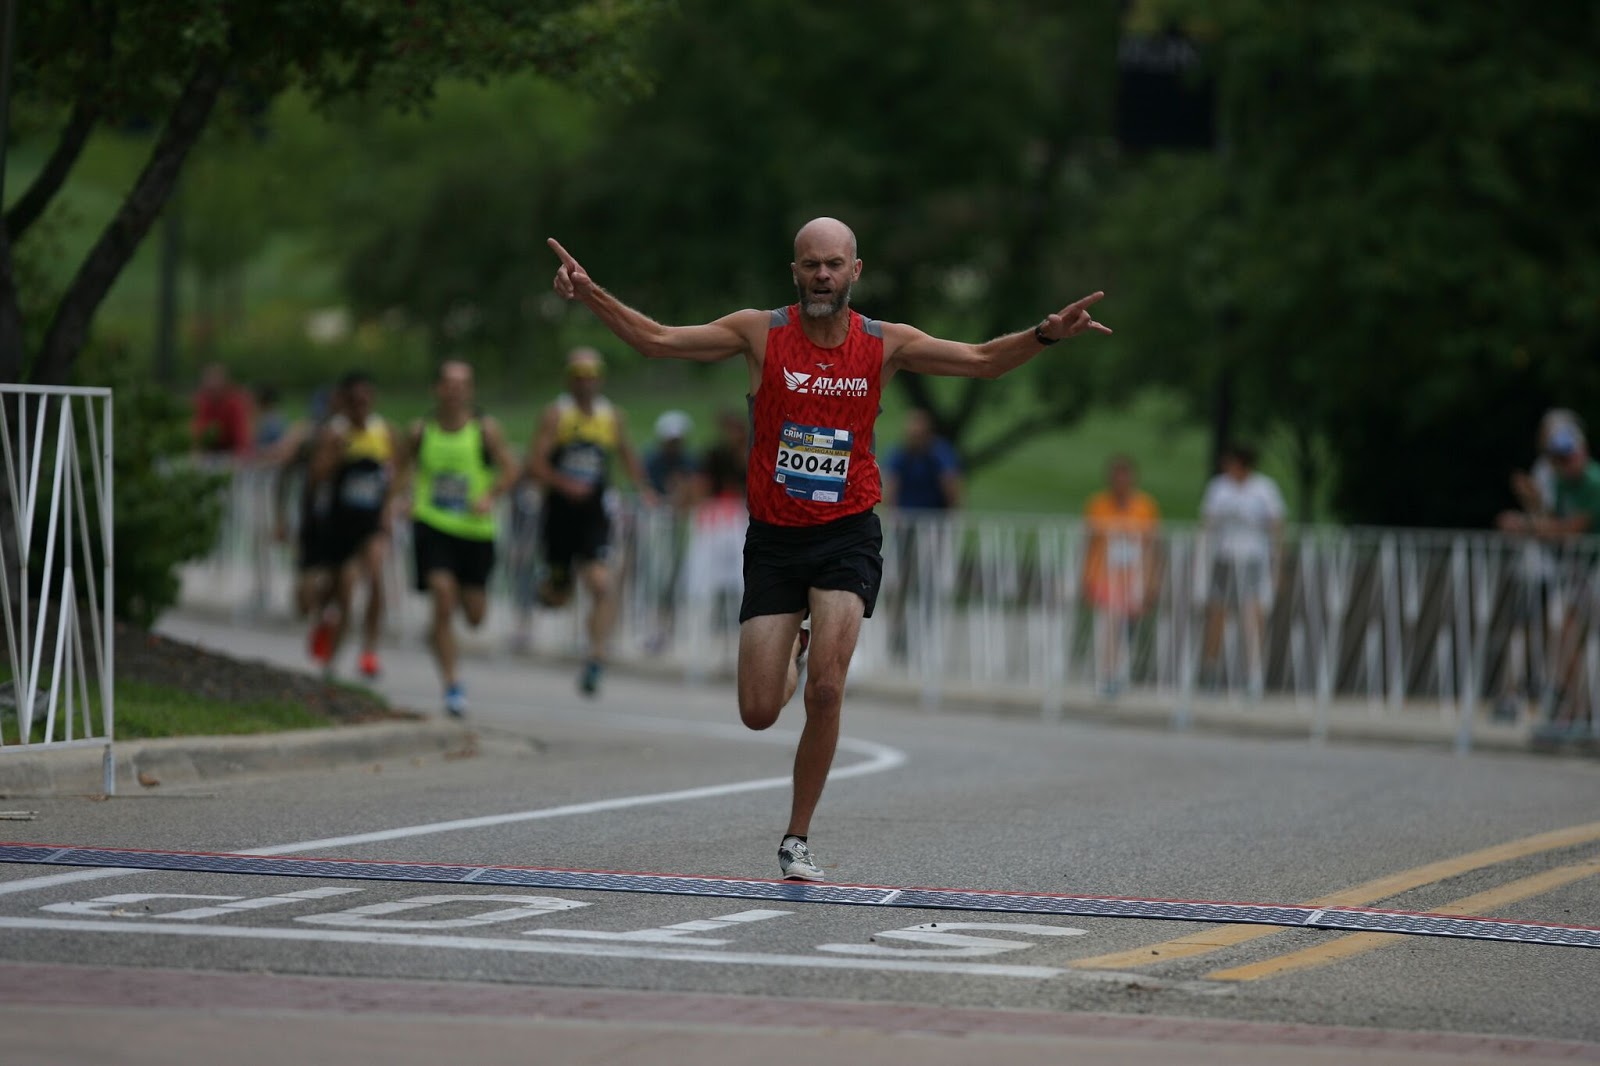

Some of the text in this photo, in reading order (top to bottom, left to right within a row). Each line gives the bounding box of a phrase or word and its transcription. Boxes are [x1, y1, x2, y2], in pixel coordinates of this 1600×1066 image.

[812, 377, 868, 390] ATLANTA
[784, 429, 802, 439] CRIM
[778, 451, 845, 475] 20044
[40, 887, 1087, 956] STOP
